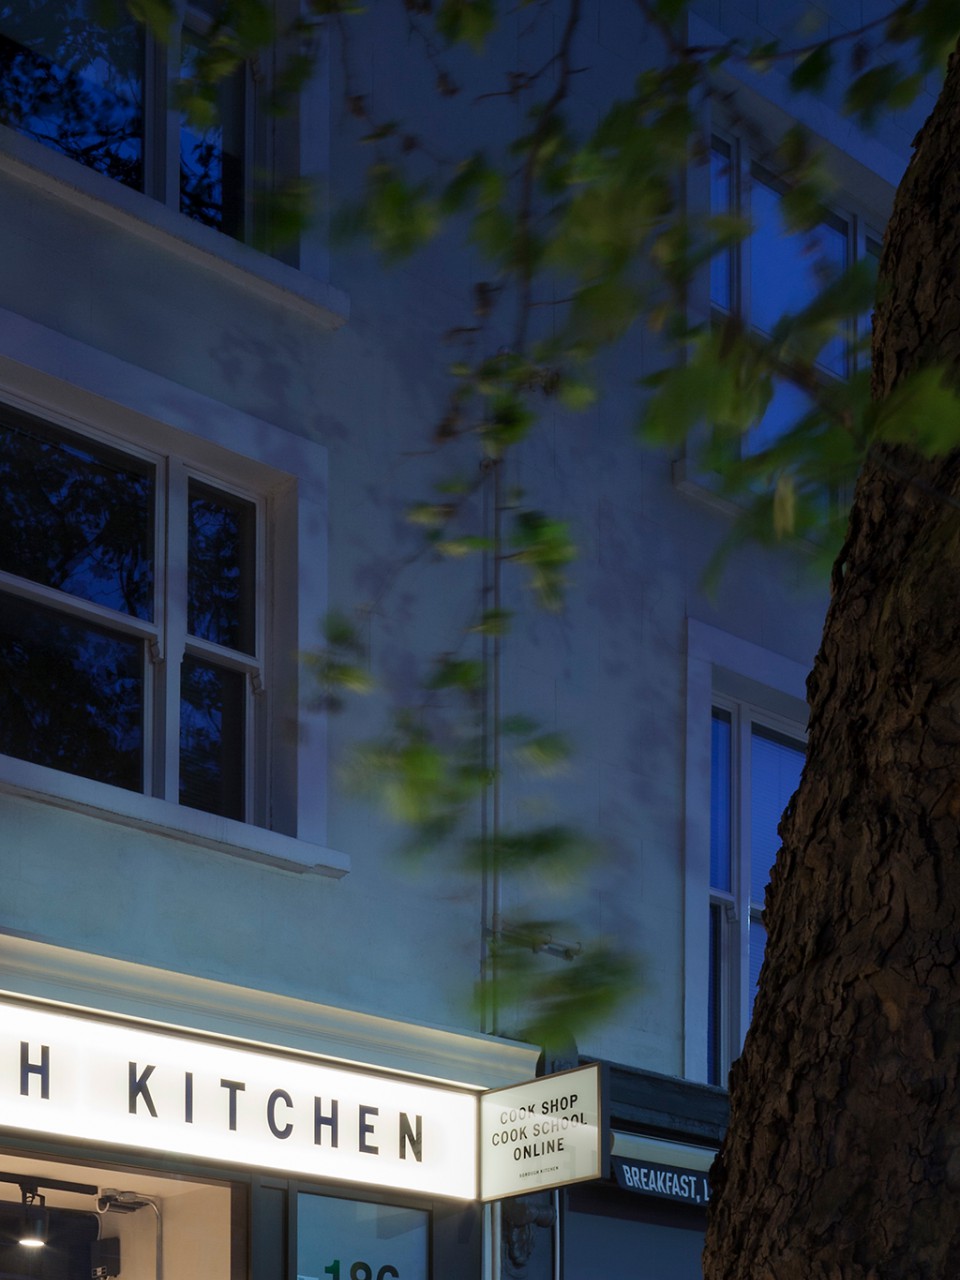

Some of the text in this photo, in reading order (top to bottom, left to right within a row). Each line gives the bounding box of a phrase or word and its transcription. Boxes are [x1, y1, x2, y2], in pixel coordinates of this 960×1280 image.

[128, 1061, 422, 1162] KITCHEN
[500, 1094, 578, 1125] COOK SHOP
[492, 1112, 588, 1146] COOK SCHOOL
[513, 1138, 564, 1161] ONLINE
[622, 1165, 700, 1203] BREAKFAST,
